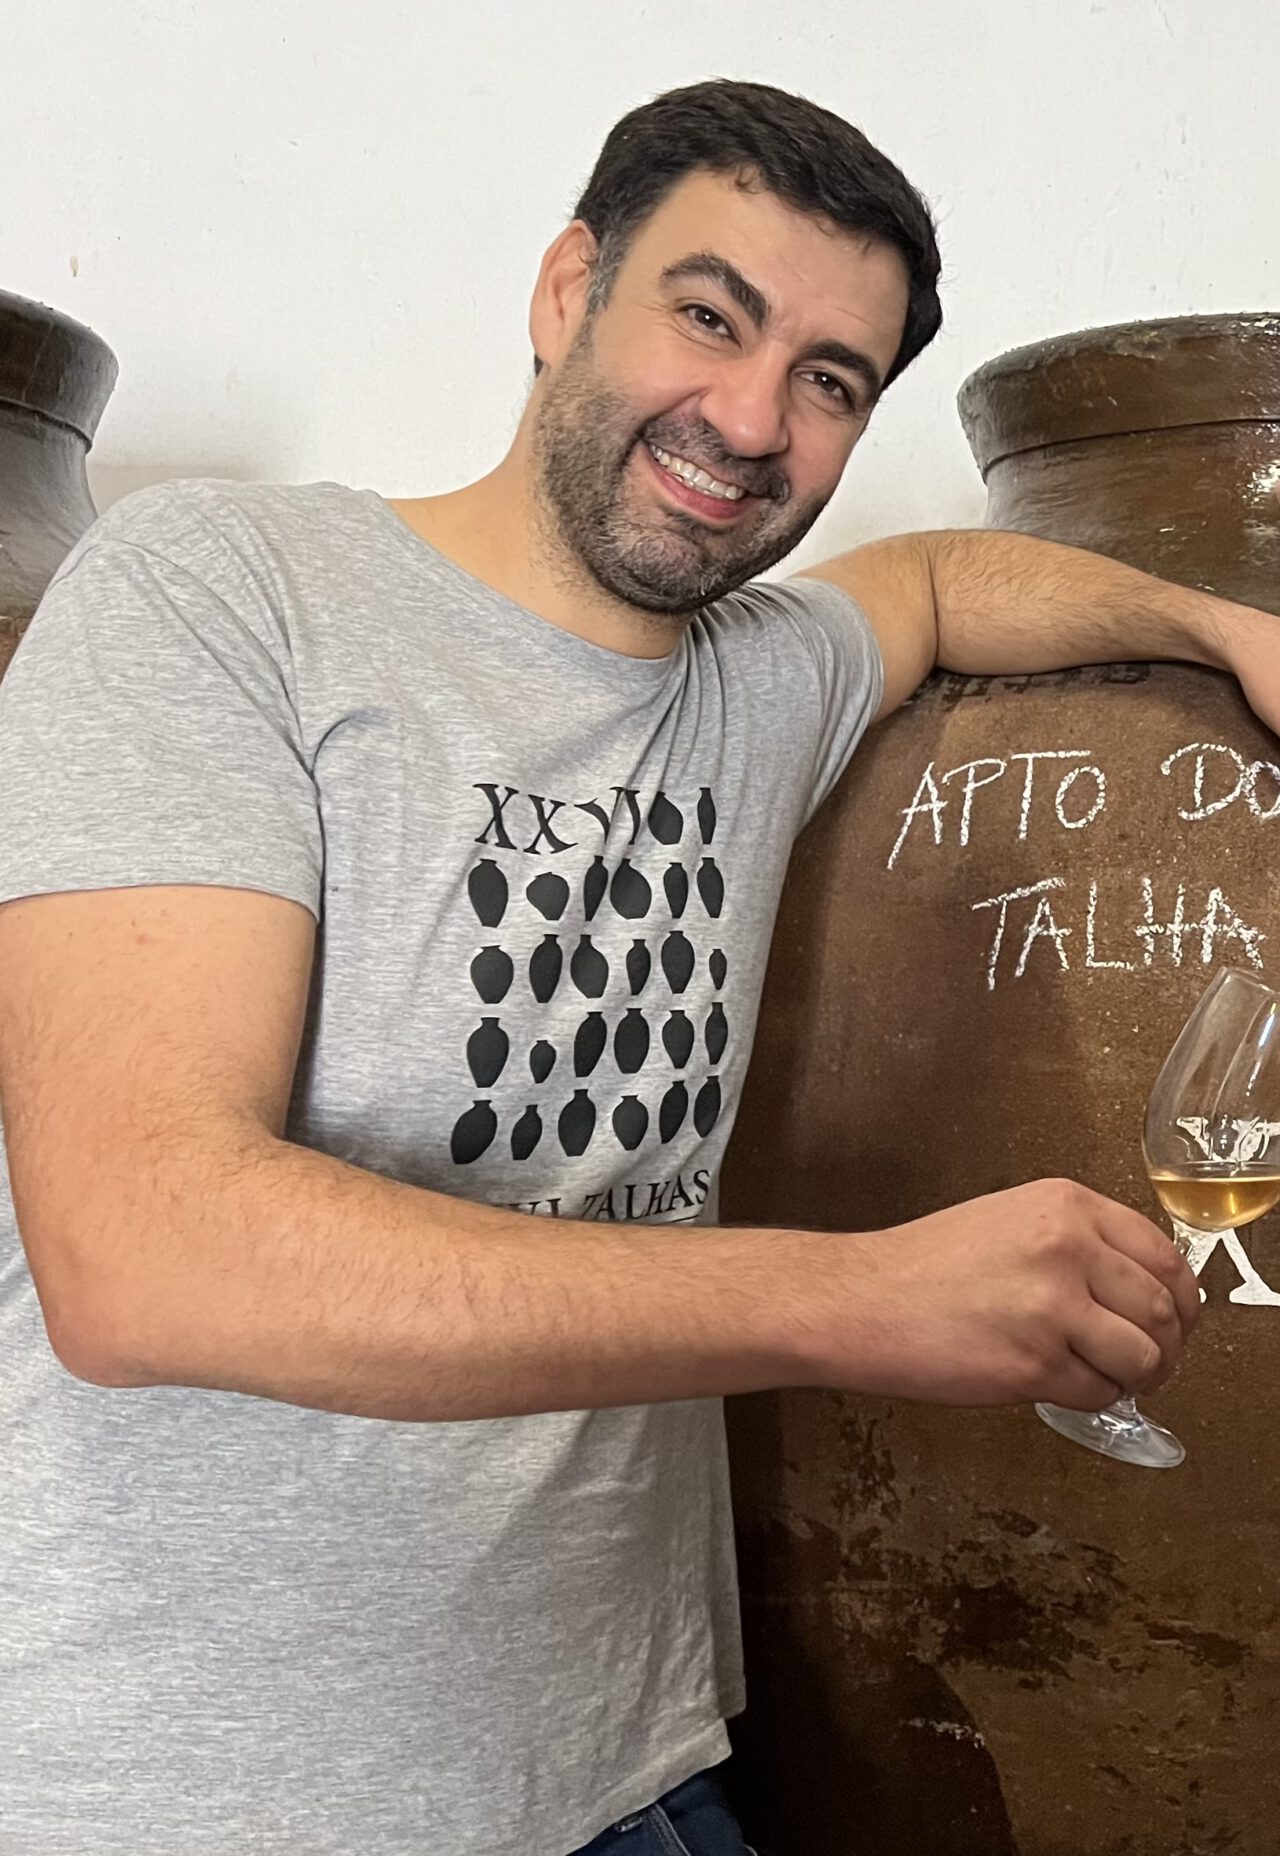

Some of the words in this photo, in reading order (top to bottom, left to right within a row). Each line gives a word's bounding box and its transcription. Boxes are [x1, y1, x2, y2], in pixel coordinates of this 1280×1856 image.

[472, 783, 640, 855] XXVI
[886, 748, 1107, 869] APTO
[971, 876, 1268, 991] TALHA
